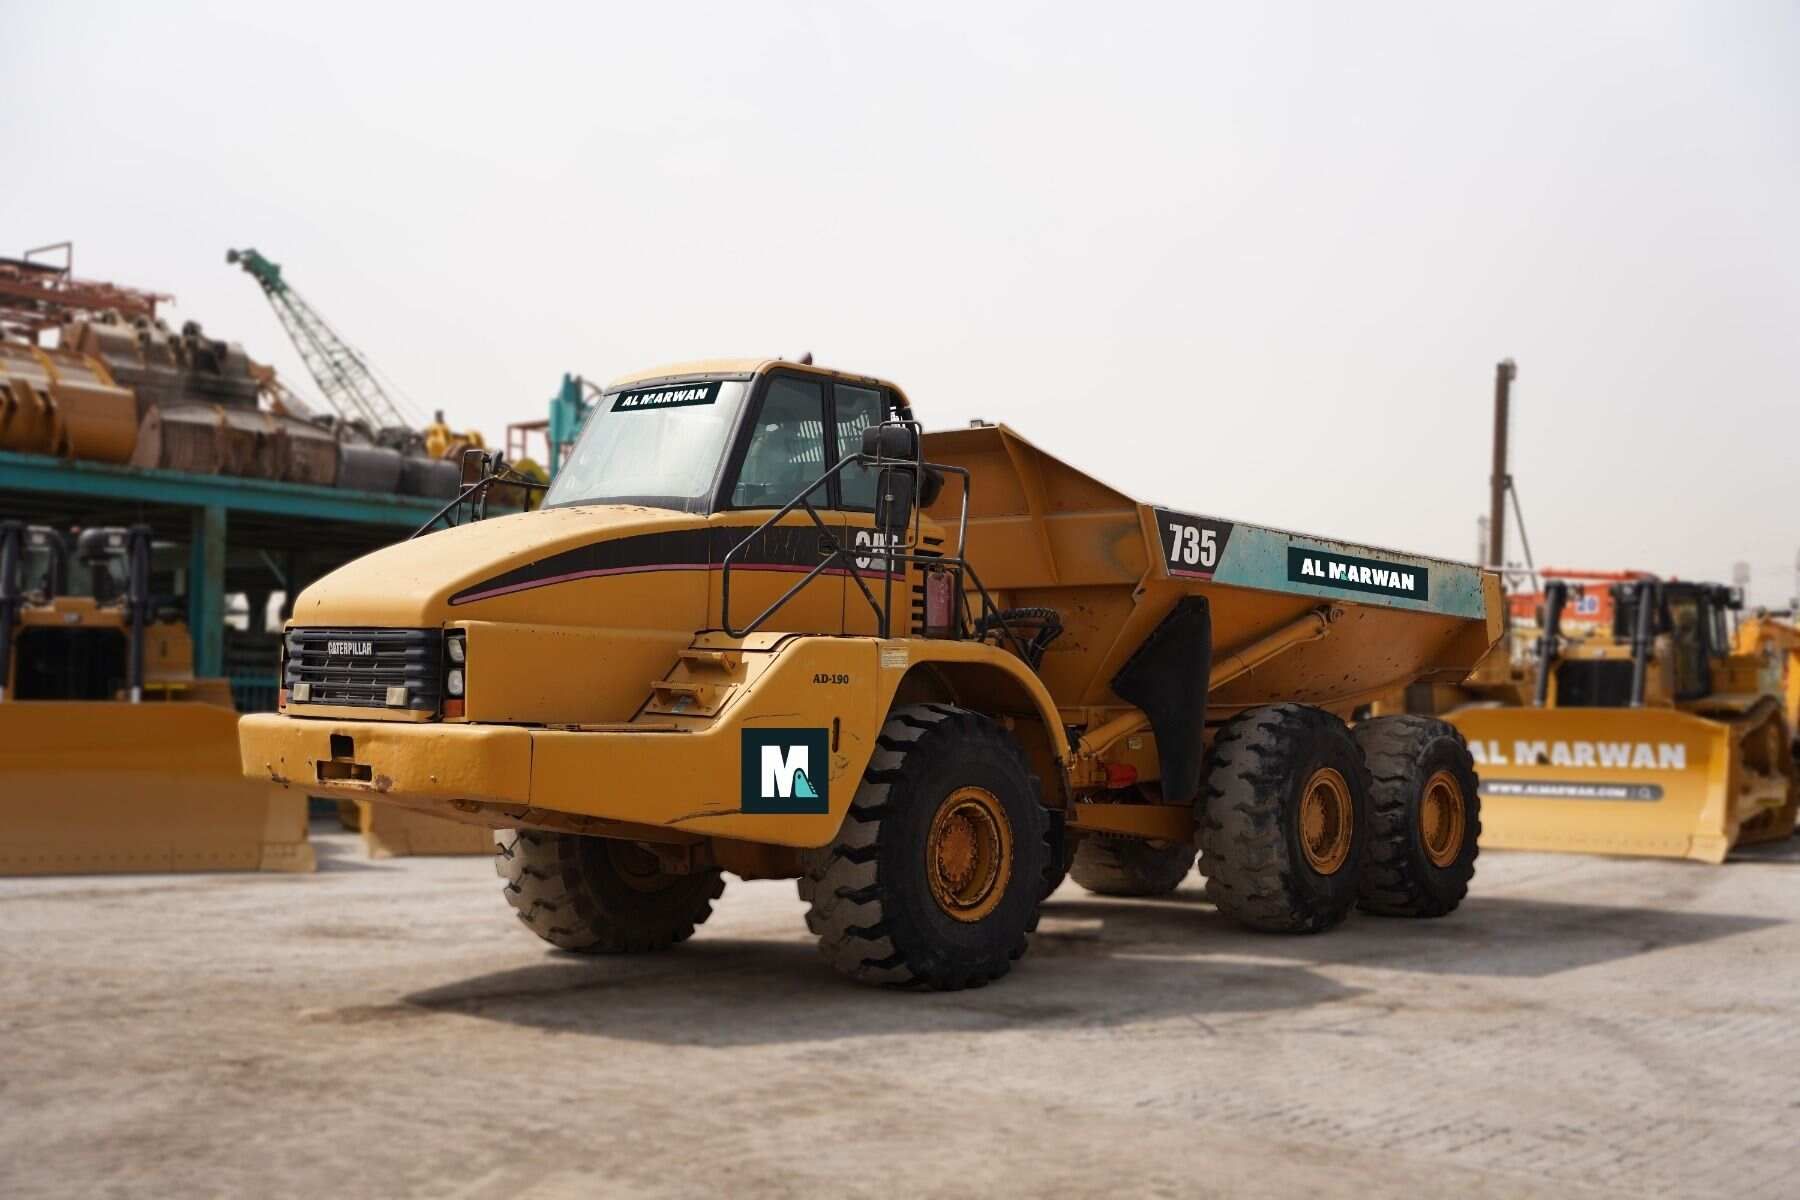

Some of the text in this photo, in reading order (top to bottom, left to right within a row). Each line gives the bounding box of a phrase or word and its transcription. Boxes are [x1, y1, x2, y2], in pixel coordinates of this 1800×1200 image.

[621, 388, 709, 407] AL MARWAN
[1169, 523, 1217, 567] 735
[1301, 558, 1414, 591] AL MARWAN
[328, 640, 373, 656] CATERPILLAR
[812, 673, 849, 684] AD-190
[1468, 740, 1687, 769] AL MARWAN
